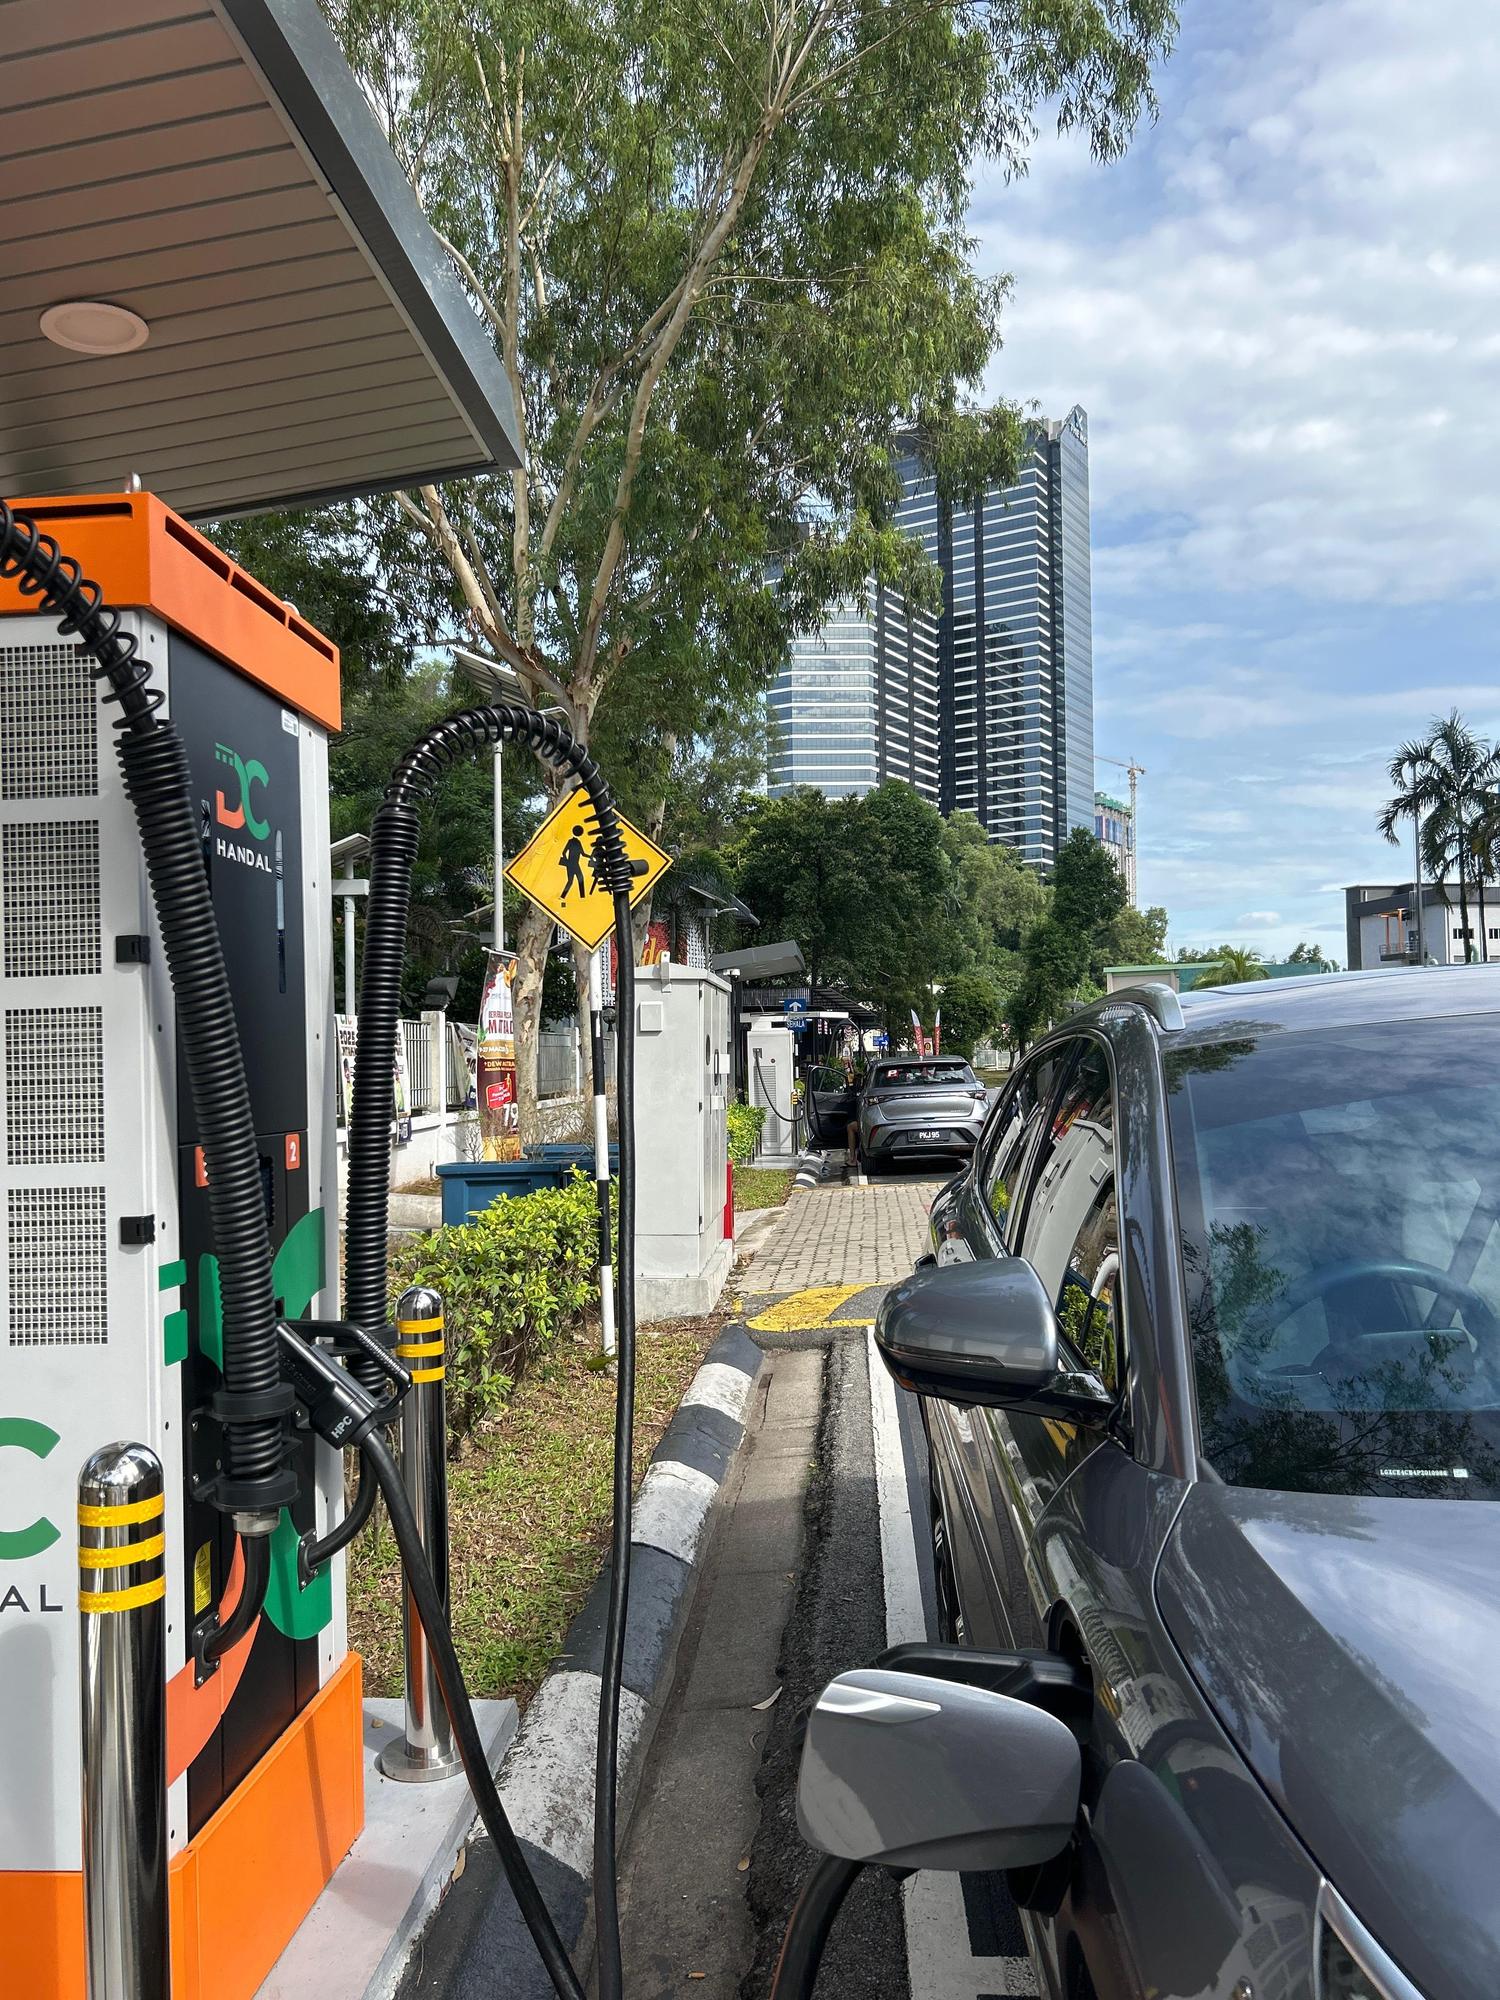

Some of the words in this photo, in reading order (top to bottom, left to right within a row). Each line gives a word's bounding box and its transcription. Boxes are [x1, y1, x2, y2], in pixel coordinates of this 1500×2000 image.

[216, 838, 272, 873] HANDAL
[290, 1141, 297, 1162] 2
[331, 1415, 353, 1439] HPC
